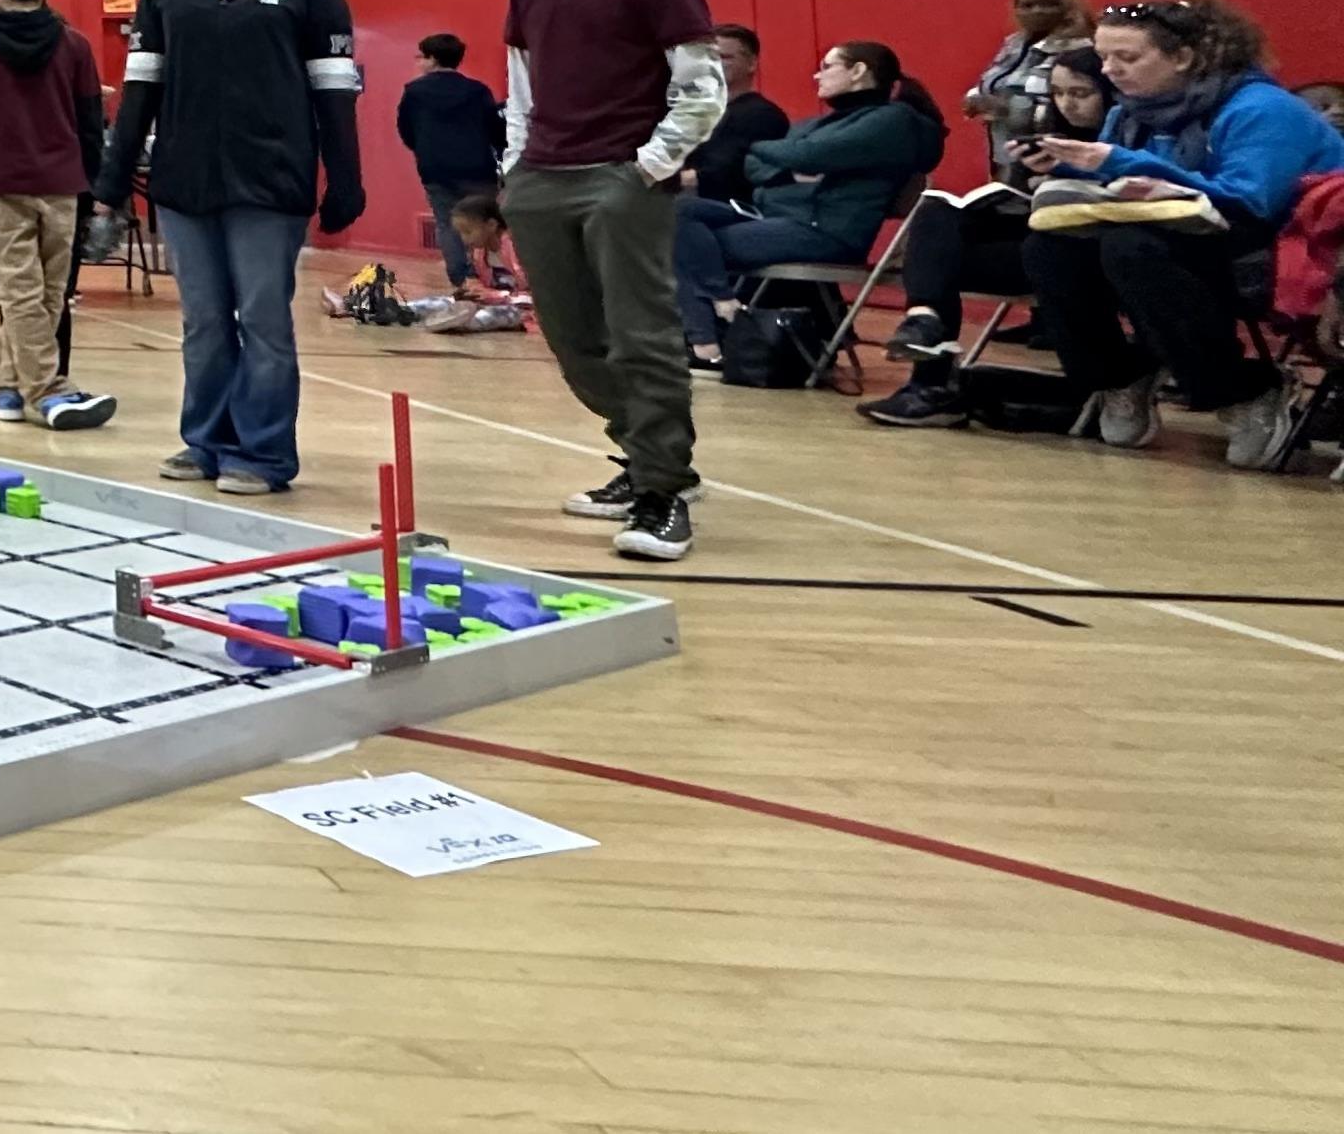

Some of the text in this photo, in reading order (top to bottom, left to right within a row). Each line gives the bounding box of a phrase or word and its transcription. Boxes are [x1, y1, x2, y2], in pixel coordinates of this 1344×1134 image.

[302, 791, 476, 828] SC Field #1
